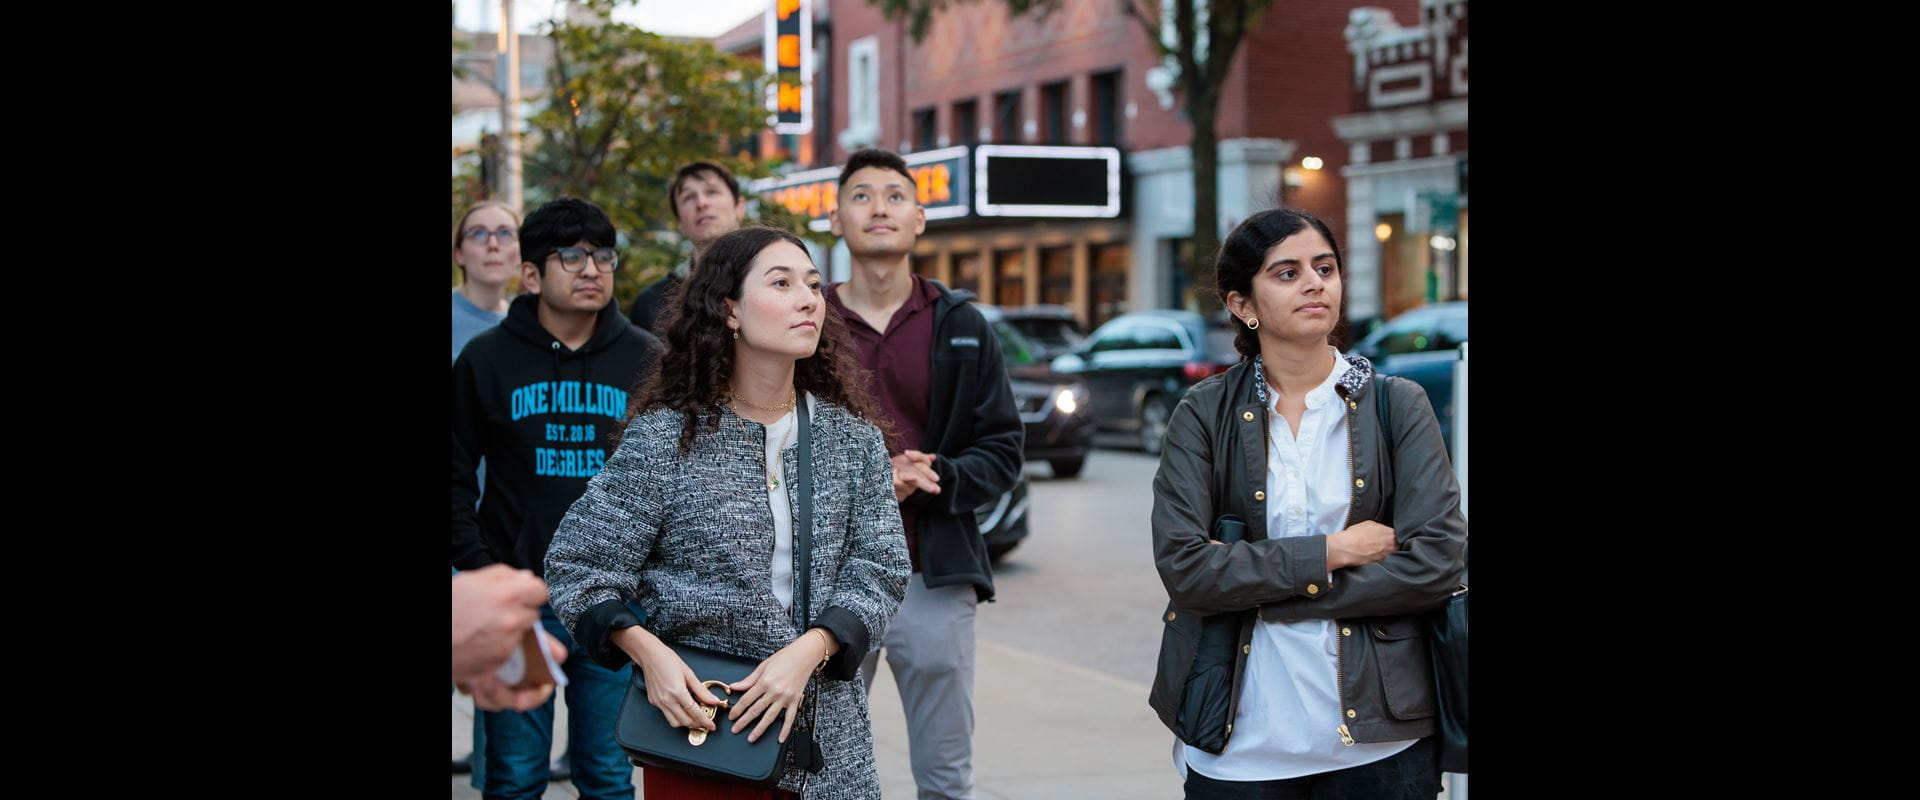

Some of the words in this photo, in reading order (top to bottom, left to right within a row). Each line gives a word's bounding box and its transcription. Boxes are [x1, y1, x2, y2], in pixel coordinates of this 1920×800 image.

[511, 381, 549, 421] ONE
[551, 380, 628, 421] MILLION
[545, 423, 570, 442] EST.
[570, 423, 596, 443] 2016
